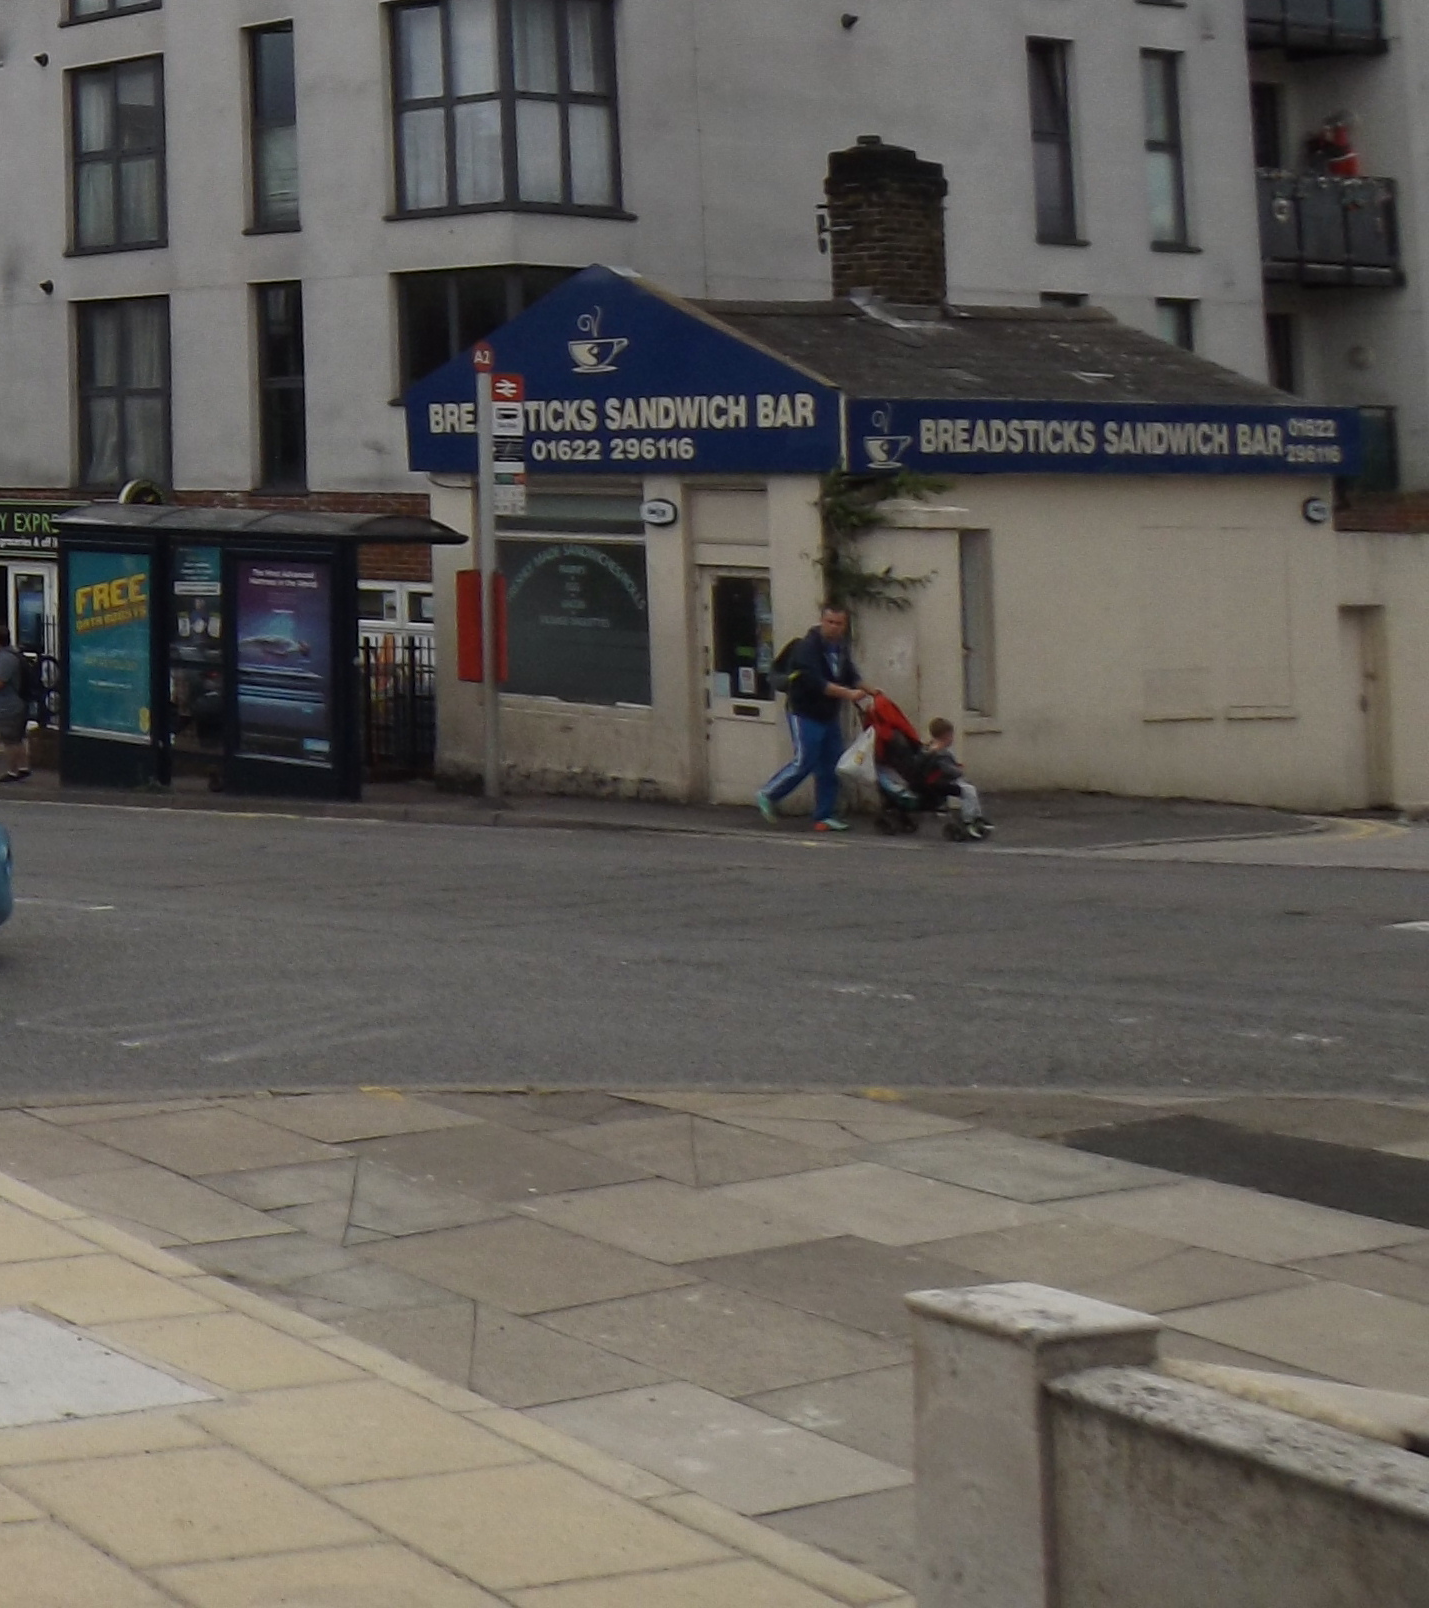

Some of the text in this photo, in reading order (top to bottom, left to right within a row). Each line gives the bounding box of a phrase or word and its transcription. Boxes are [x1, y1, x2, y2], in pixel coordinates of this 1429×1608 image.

[428, 393, 816, 434] BRETICKS SANDWICH BAR
[1288, 418, 1336, 438] 01622
[531, 438, 695, 461] 01622 296116
[919, 418, 1284, 456] BREADSTICKS SANDWICH BAR
[75, 573, 147, 616] FREE
